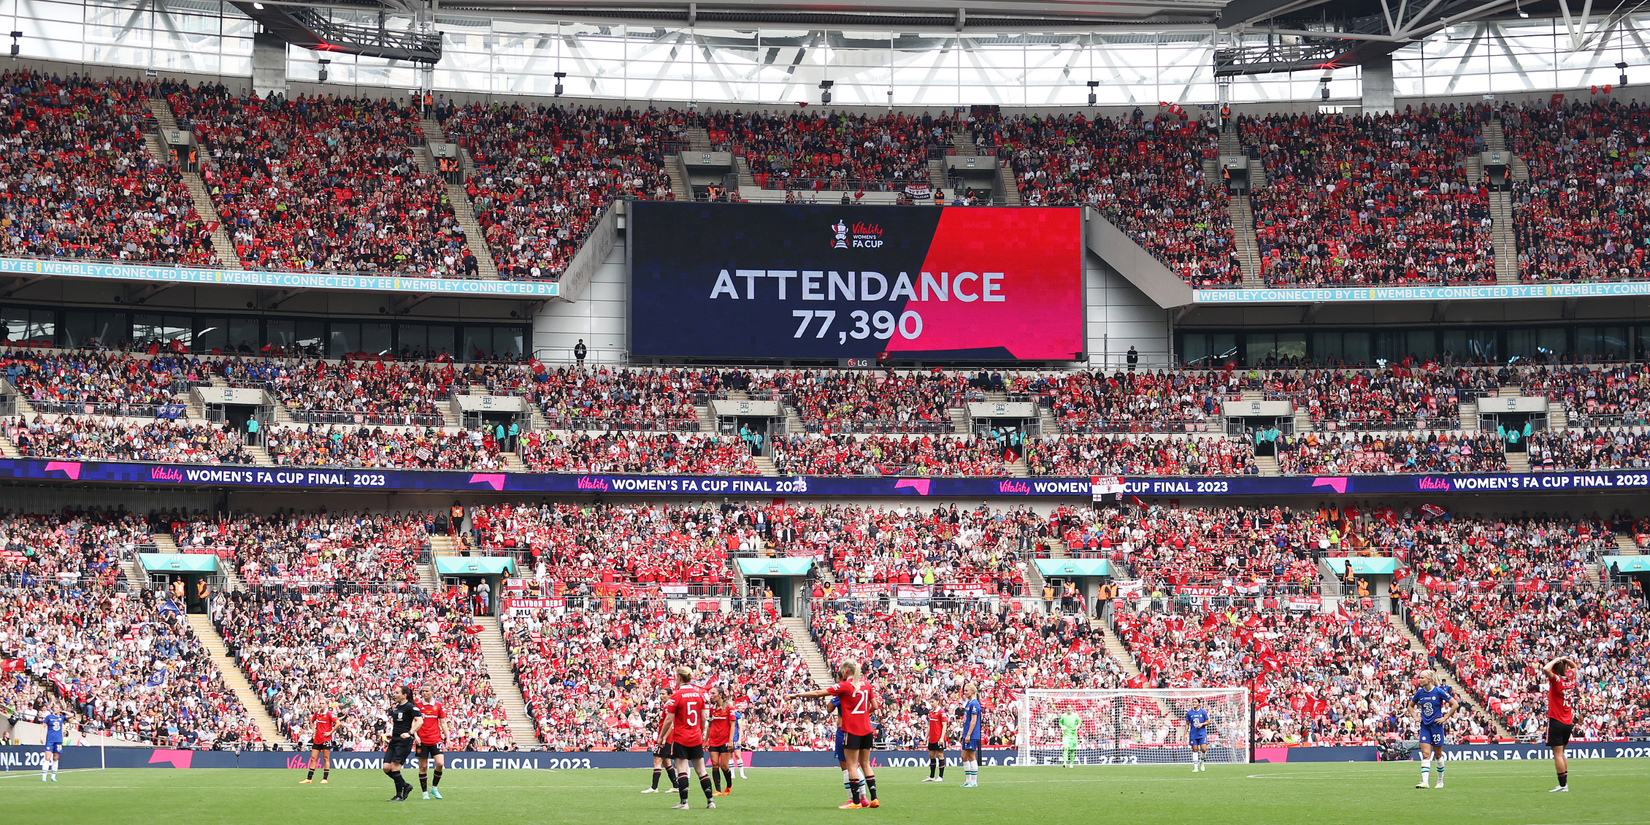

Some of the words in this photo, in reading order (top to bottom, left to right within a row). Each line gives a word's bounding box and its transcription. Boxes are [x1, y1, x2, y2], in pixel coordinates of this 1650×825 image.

[852, 221, 883, 238] Vitality
[853, 240, 864, 248] FA
[865, 240, 883, 248] CUP
[2, 261, 17, 270] BY
[20, 262, 33, 271] EE
[44, 263, 102, 275] WEMBLEY
[105, 267, 177, 278] CONNECTED
[181, 270, 197, 279] BY
[199, 271, 212, 280] EE
[223, 272, 282, 283] WEMBLEY
[284, 275, 355, 286] CONNECTED
[360, 278, 375, 287] BY
[378, 279, 391, 287] EE
[402, 280, 460, 290] WEMBLEY
[463, 282, 534, 292] CONNECTED
[538, 284, 554, 292] BY
[710, 269, 1006, 302] ATTENDANCE
[1200, 291, 1259, 300] WEMBLEY
[1260, 290, 1332, 300] CONNECTED
[1335, 290, 1351, 299] BY
[1354, 290, 1366, 298] EE
[1376, 289, 1434, 298] WEMBLEY
[1437, 287, 1508, 297] CONNECTED
[1512, 287, 1527, 296] BY
[1530, 287, 1543, 295] EE
[1553, 285, 1611, 295] WEMBLEY
[793, 310, 923, 345] 77,390
[152, 466, 183, 483] Vitality
[187, 470, 252, 482] WOMEN'S
[258, 472, 273, 483] FA
[277, 473, 303, 483] CUP
[354, 475, 385, 485] 2023
[1419, 476, 1450, 491] Vitality
[1454, 478, 1519, 488] WOMEN'S
[1524, 477, 1539, 487] FA
[1543, 477, 1569, 487] CUP
[1574, 476, 1612, 486] FINAL
[1617, 475, 1647, 485] 2023
[578, 476, 609, 492] Vitality
[612, 479, 677, 490] WOMEN'S
[683, 481, 698, 490] FA
[702, 481, 728, 491] CUP
[733, 481, 772, 491] FINAL
[1000, 477, 1030, 495] Vitality
[1034, 482, 1091, 492] WOMEN'
[1123, 482, 1149, 492] CUP
[1154, 482, 1193, 492] FINAL
[1197, 482, 1228, 492] 2023
[851, 690, 868, 714] 21
[687, 702, 698, 726] 5
[1432, 734, 1441, 742] 23
[25, 751, 54, 766] 202
[1503, 750, 1522, 760] FA
[1615, 748, 1650, 758] 2023
[333, 758, 419, 769] WOM'S
[451, 758, 487, 769] CUP
[550, 758, 591, 769] 2023
